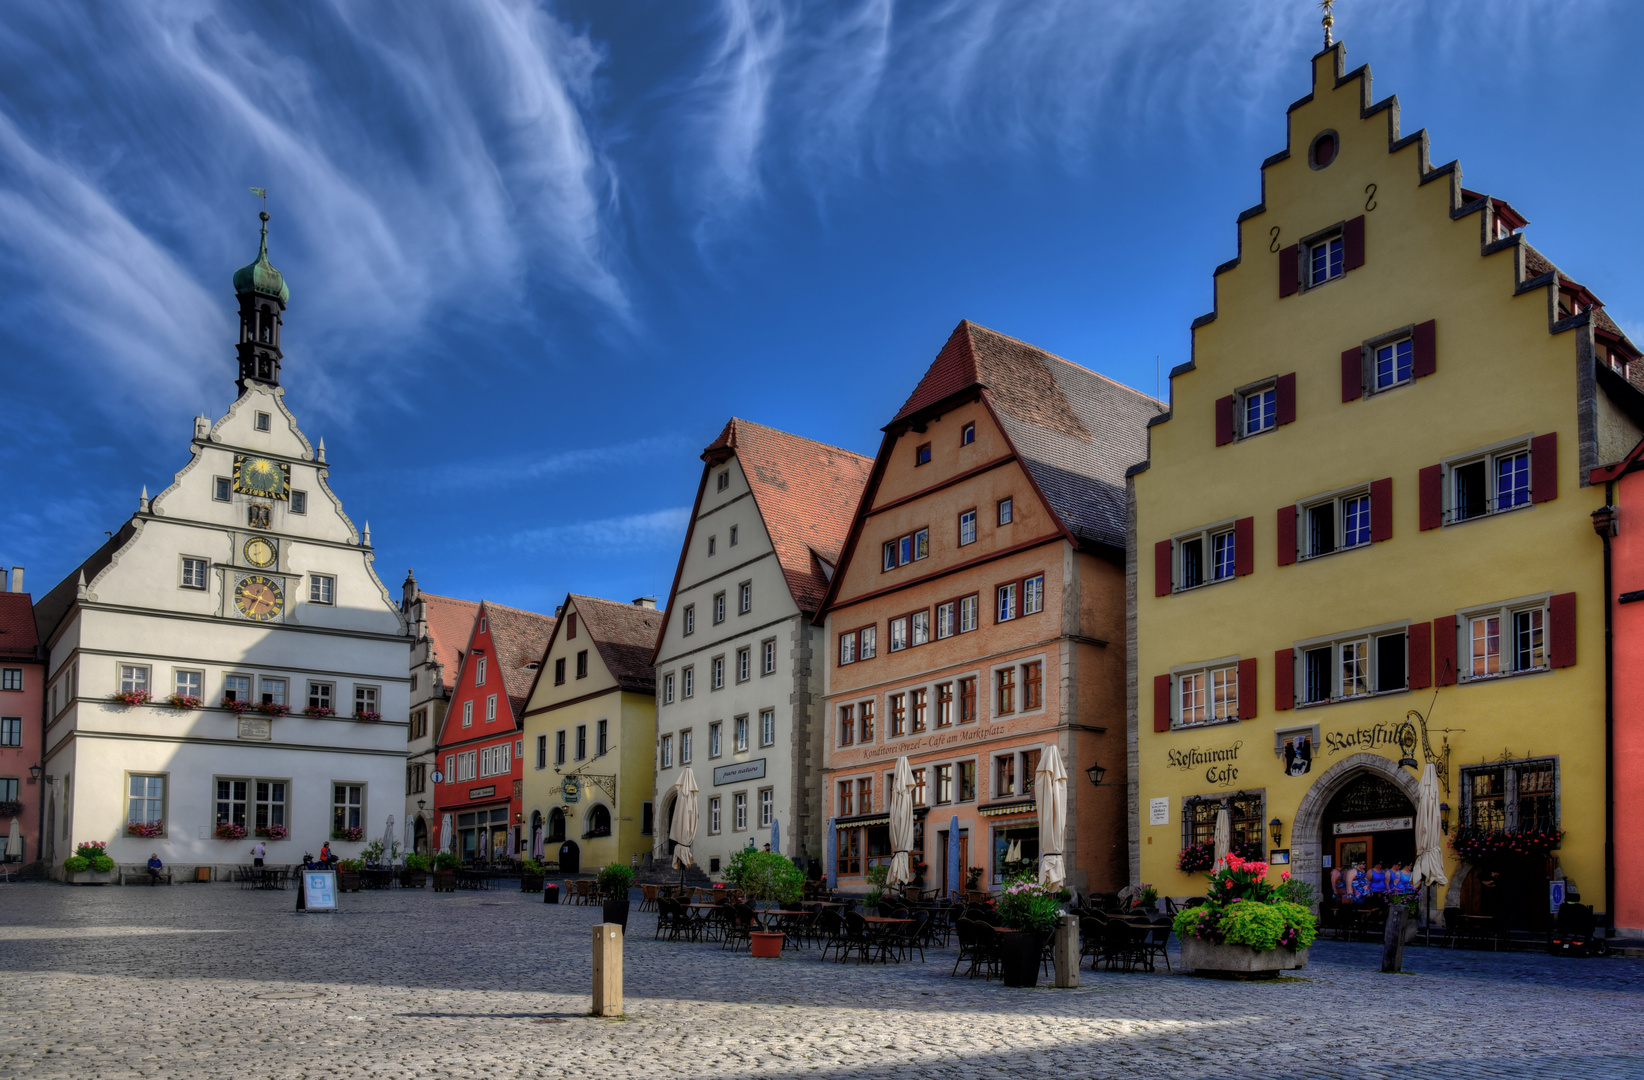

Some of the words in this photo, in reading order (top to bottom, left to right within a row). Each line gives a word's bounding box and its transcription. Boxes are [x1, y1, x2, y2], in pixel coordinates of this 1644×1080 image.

[863, 744, 898, 759] Konditorei
[898, 739, 921, 753] Prezel
[928, 734, 946, 748] Café
[946, 736, 958, 744] am
[959, 725, 1005, 742] Marktplatz
[1325, 720, 1404, 756] Ratsstub
[1166, 740, 1243, 771] Restaurant
[722, 770, 737, 779] pura
[737, 766, 758, 775] natura
[1205, 763, 1239, 787] Cafe
